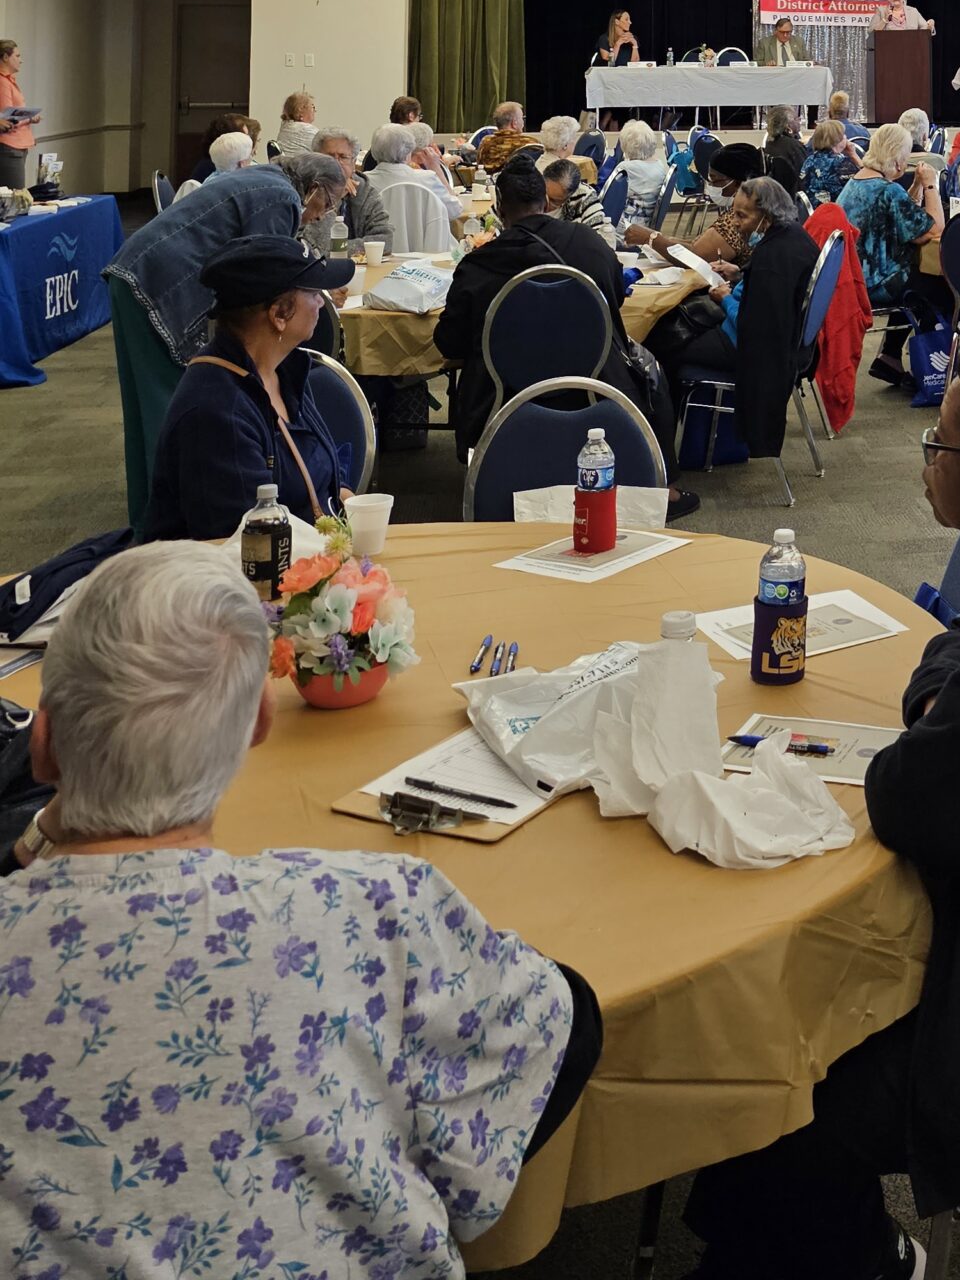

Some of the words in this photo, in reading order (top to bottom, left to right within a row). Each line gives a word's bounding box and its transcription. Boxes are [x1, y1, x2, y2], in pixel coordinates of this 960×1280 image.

[776, 0, 826, 11] District
[851, 15, 871, 24] PAR
[44, 269, 79, 320] EPIC
[278, 537, 289, 577] INTS
